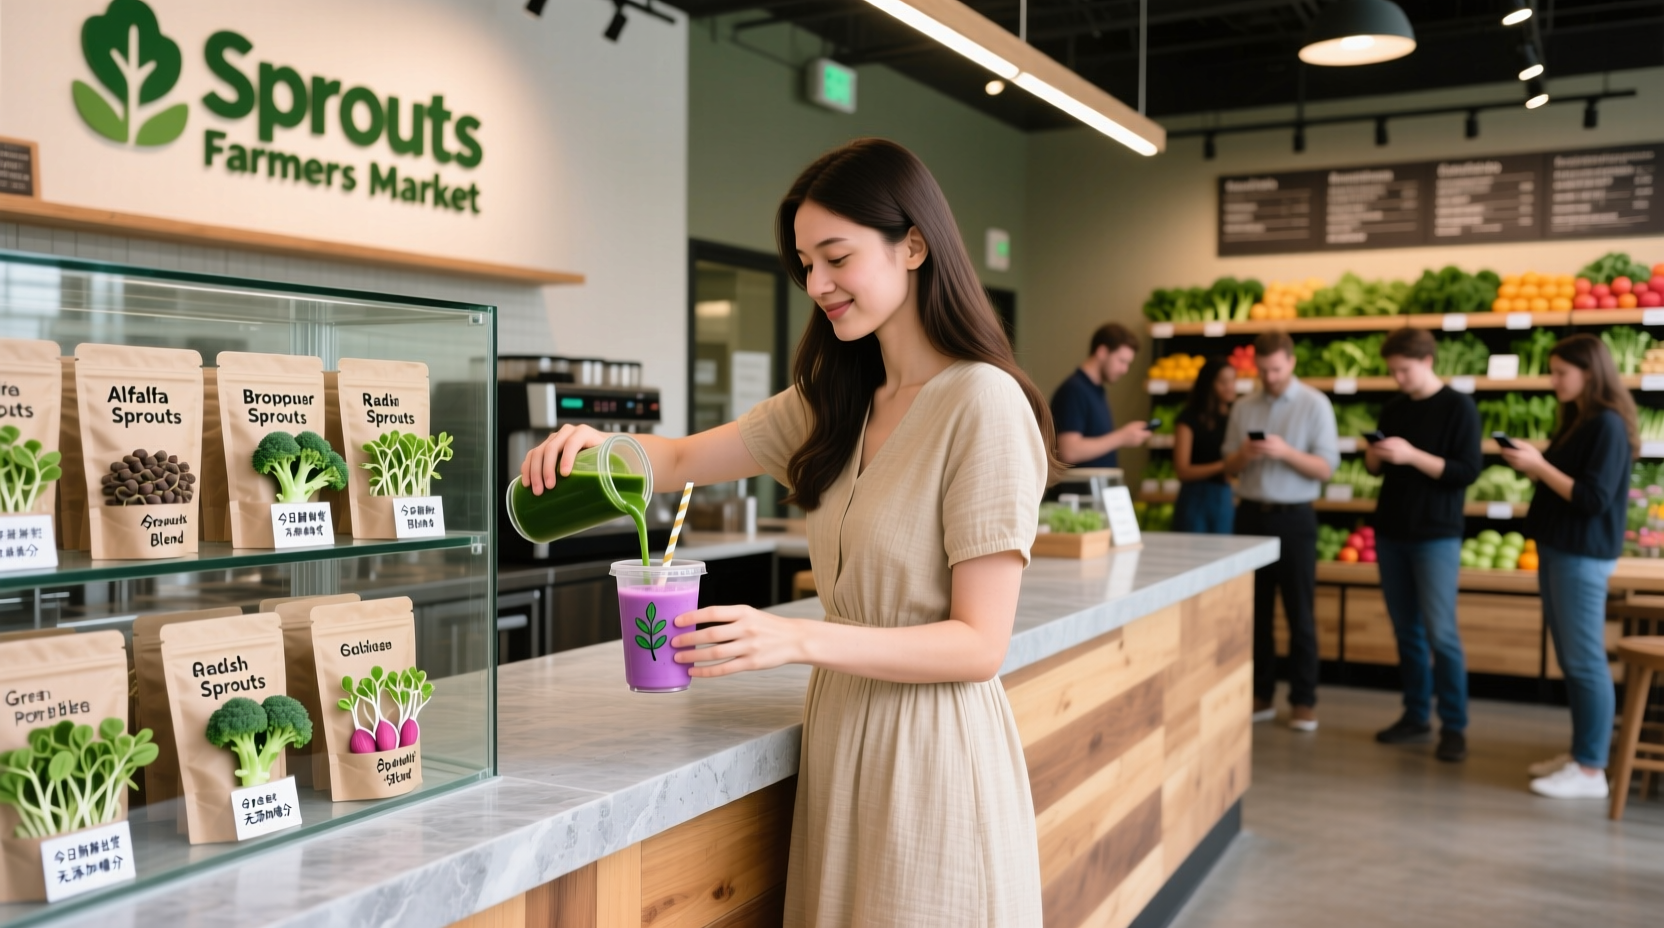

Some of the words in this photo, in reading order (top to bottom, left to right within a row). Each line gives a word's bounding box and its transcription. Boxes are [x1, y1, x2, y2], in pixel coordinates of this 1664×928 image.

[201, 30, 483, 169] Sprouts
[204, 129, 357, 191] Farmers
[369, 162, 481, 214] Market
[112, 406, 182, 429] Sprouts
[248, 407, 307, 427] Sprouts
[366, 409, 415, 428] Sprouts
[200, 674, 266, 701] Sprouts
